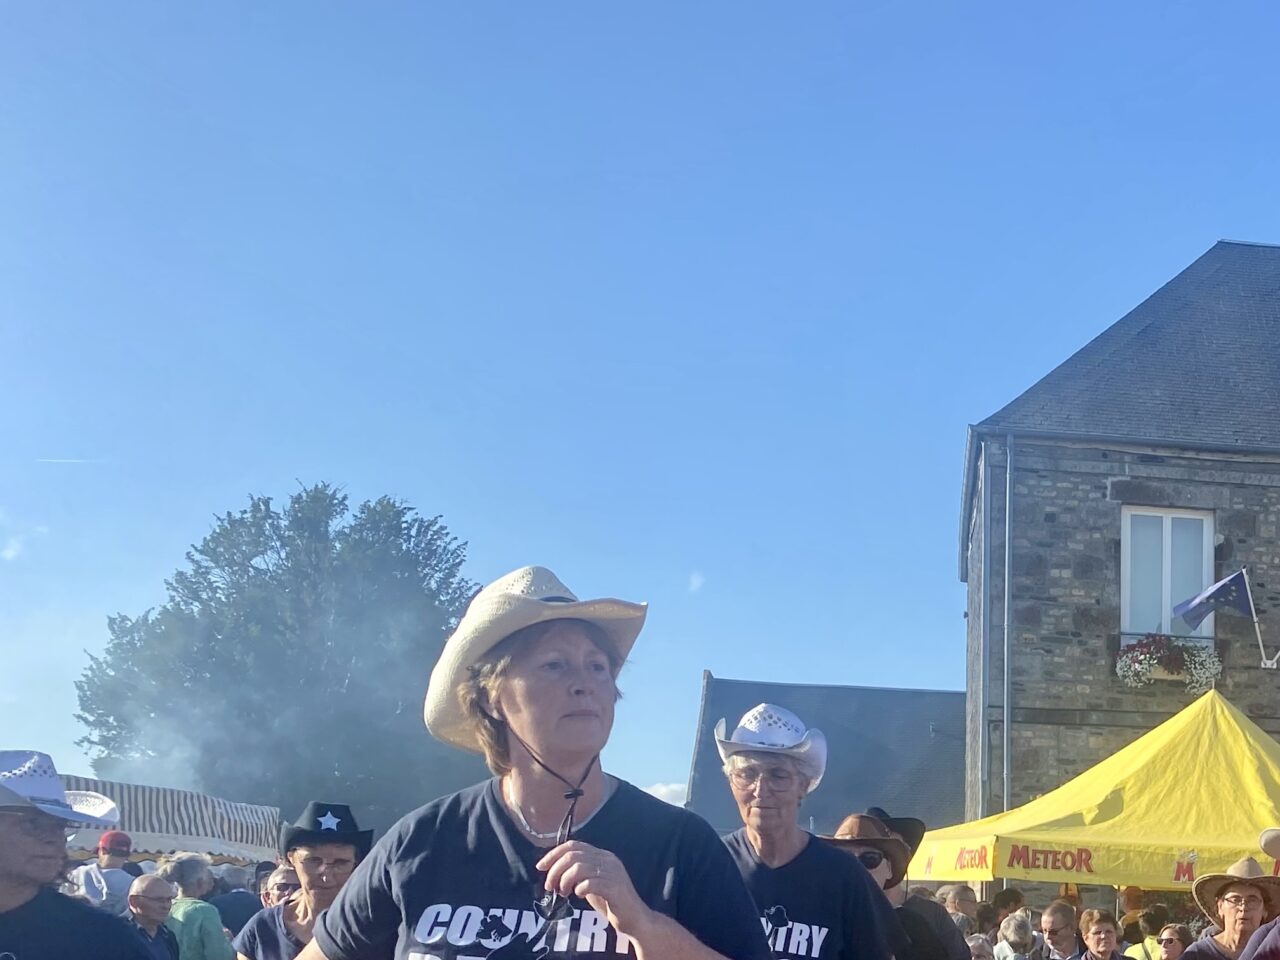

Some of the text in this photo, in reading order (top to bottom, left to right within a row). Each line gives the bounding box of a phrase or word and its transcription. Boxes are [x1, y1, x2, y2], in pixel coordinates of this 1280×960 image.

[954, 845, 989, 871] METEOR
[1007, 844, 1094, 873] METEOR
[1173, 861, 1196, 882] M
